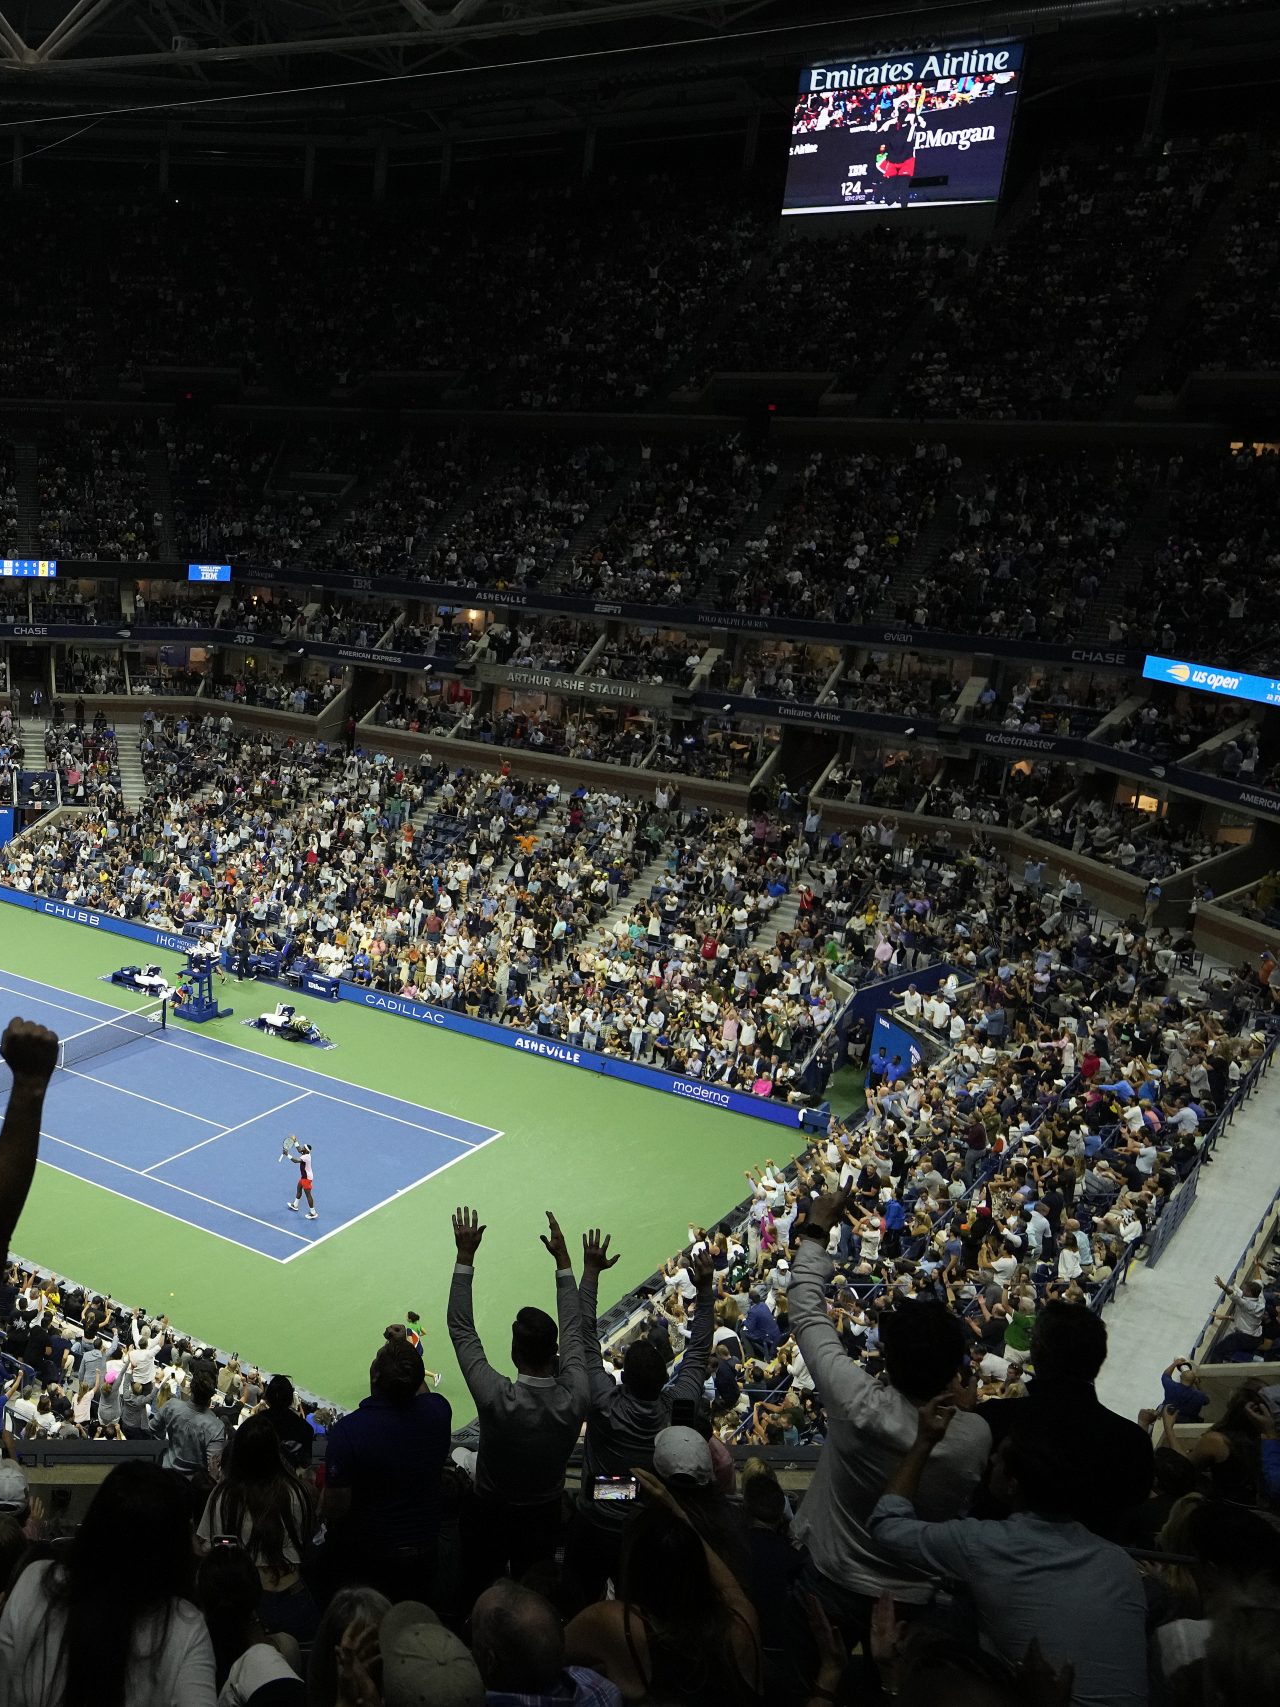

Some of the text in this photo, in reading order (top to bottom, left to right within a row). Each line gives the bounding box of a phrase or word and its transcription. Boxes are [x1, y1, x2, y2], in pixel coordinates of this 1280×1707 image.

[810, 49, 1010, 91] Emirates Airline
[841, 180, 861, 196] 124
[352, 578, 373, 590] IBM
[594, 603, 622, 614] ESPN
[13, 626, 48, 635] CHASE
[883, 632, 913, 643] evian
[233, 634, 255, 645] ATP
[338, 649, 402, 664] AMERICAN EXPRESS
[1071, 650, 1128, 665] CHASE
[507, 671, 640, 698] ARTHUR ASHE STADIUM
[1191, 670, 1239, 690] us open
[778, 706, 841, 722] Emirates Airline
[984, 732, 1056, 750] ticketmaster
[44, 902, 100, 926] CHUBB
[156, 933, 176, 948] IHG
[365, 994, 445, 1024] CADILLAC
[673, 1080, 730, 1104] moderna
